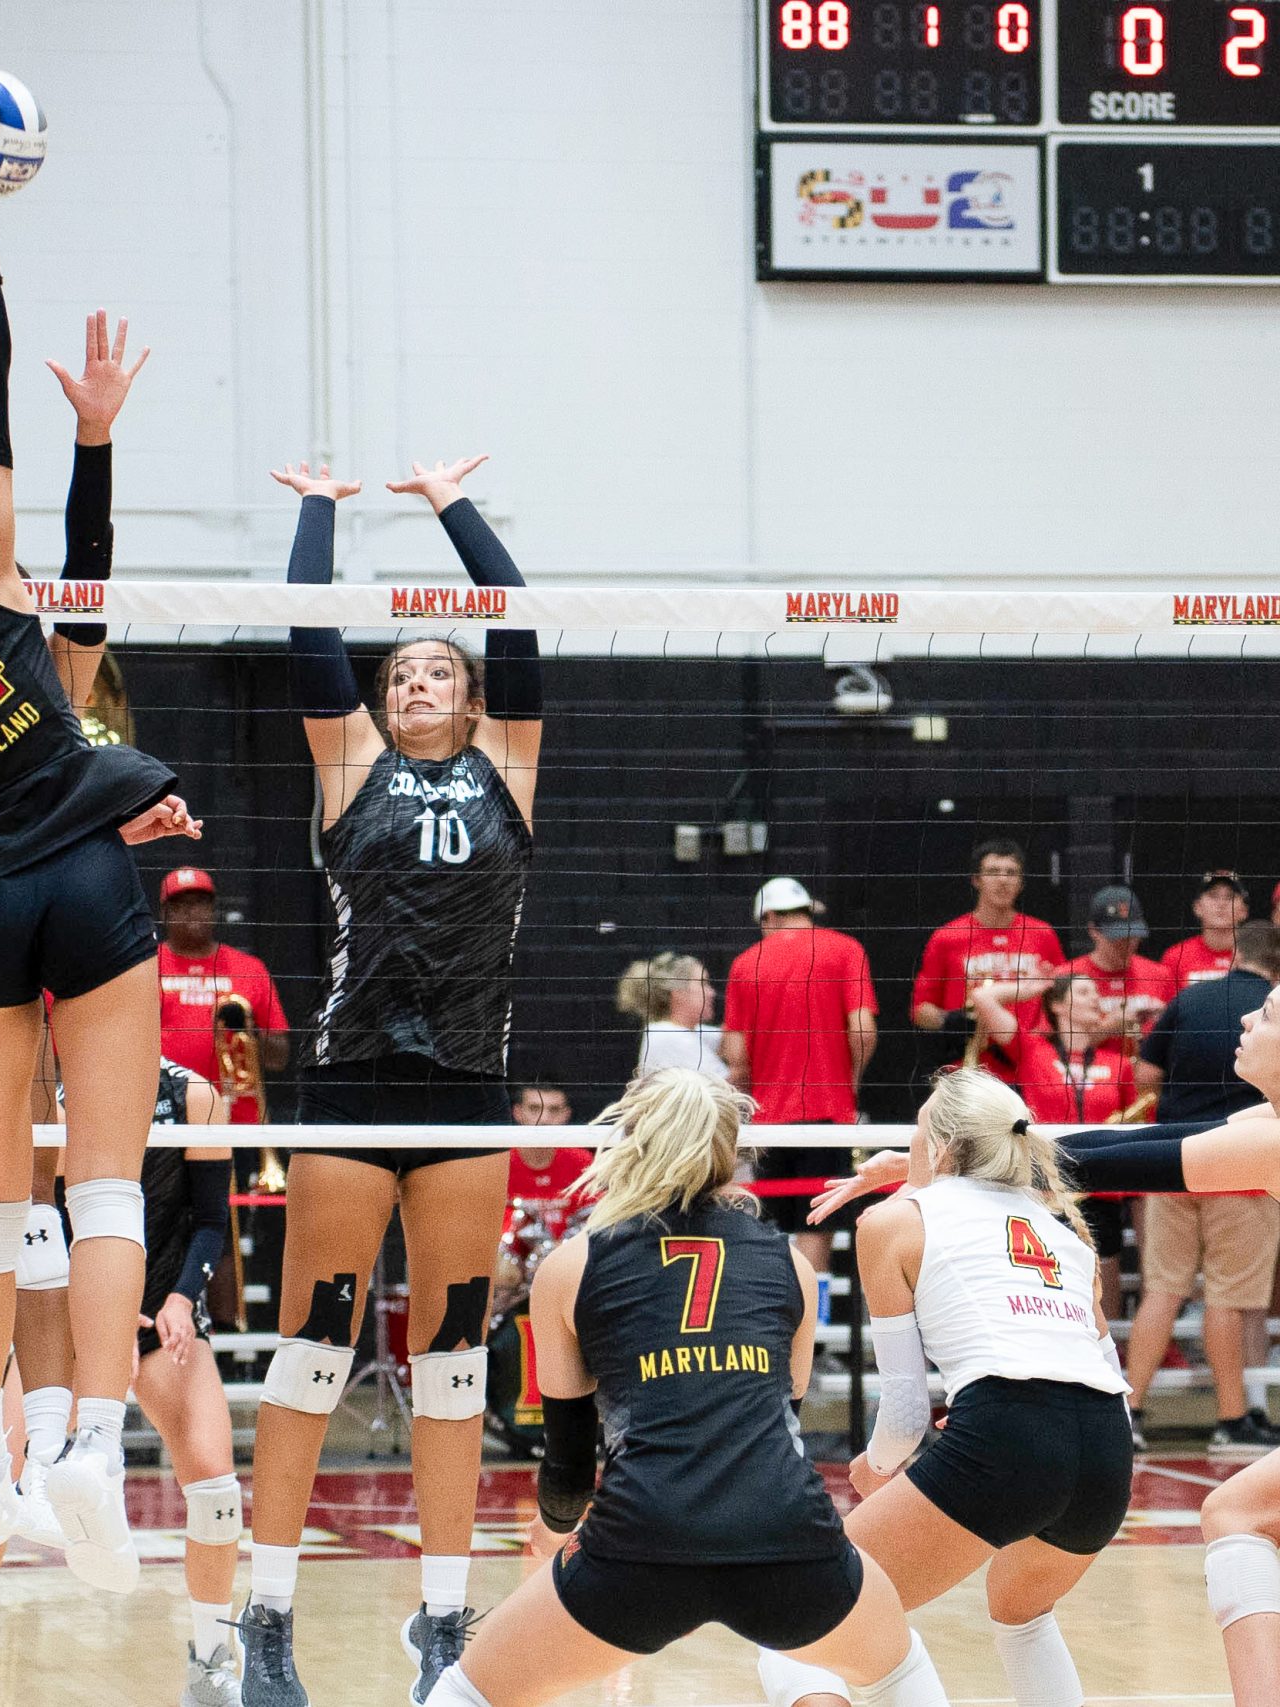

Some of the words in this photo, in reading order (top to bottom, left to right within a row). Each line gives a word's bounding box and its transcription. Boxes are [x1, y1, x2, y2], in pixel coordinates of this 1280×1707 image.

[998, 3, 1028, 52] 0
[1123, 7, 1163, 75] 0
[1225, 8, 1265, 76] 2
[1089, 91, 1176, 120] SCORE
[391, 588, 506, 612] MARYLAND
[786, 592, 899, 617] MARYLAND
[413, 807, 471, 864] 10
[1006, 1215, 1063, 1291] 4
[660, 1236, 725, 1333] 7
[1007, 1295, 1089, 1328] MARYLAND
[640, 1345, 769, 1382] MARYLAND
